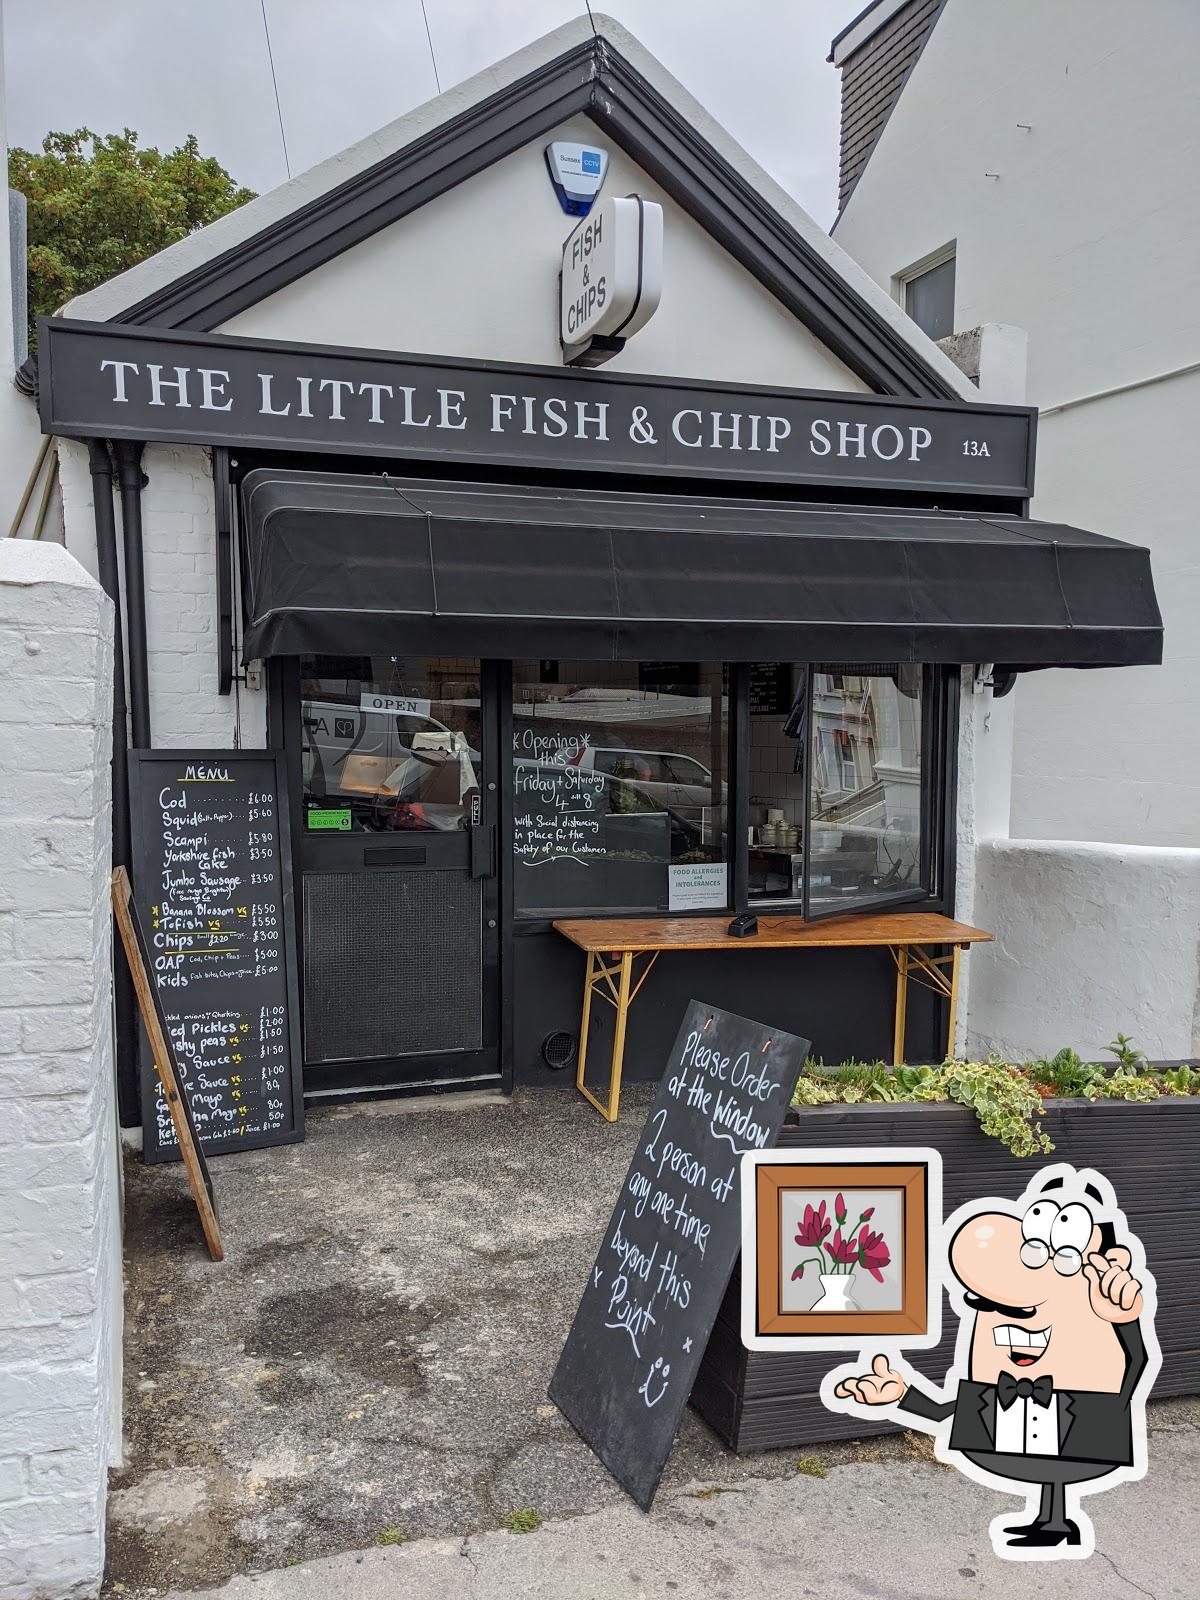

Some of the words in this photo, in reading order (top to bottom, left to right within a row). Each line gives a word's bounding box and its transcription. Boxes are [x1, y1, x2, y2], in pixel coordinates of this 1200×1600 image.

[583, 159, 600, 168] CCTV
[571, 214, 603, 270] FISH
[582, 264, 590, 286] &
[567, 276, 606, 334] CHIPS
[100, 359, 234, 411] THE
[257, 372, 469, 430] LITTLE
[489, 393, 610, 441] FISH
[629, 405, 658, 445] &
[671, 409, 792, 453] CHIP
[809, 418, 932, 462] SHOP
[962, 440, 991, 458] 13A
[372, 699, 418, 713] OPEN
[523, 729, 579, 759] Opening
[538, 751, 566, 766] this
[185, 765, 229, 780] MENU
[564, 766, 605, 793] Saturday
[159, 787, 187, 810] Cod
[555, 794, 570, 811] 4
[583, 792, 593, 809] 8
[162, 811, 198, 831] Squid
[562, 815, 599, 834] distancing
[163, 831, 208, 851] Scampi
[514, 829, 523, 840] in
[527, 829, 554, 843] place
[555, 828, 567, 842] for
[568, 829, 585, 839] the
[541, 841, 553, 854] of
[555, 845, 569, 853] our
[163, 849, 210, 868] Yorkshire
[161, 869, 196, 890] Jumbo
[200, 872, 242, 890] Sausage
[675, 880, 721, 888] INTOLERANCES
[162, 901, 193, 917] Banana
[195, 903, 234, 916] Blossom
[160, 916, 204, 931] Tofish
[153, 932, 194, 952] Chips
[157, 971, 189, 988] Kids
[192, 1020, 237, 1035] Pickles
[200, 1036, 227, 1054] peas
[193, 1055, 231, 1070] Sauce
[680, 1031, 730, 1081] Please
[731, 1051, 781, 1102] Order
[197, 1073, 229, 1090] Sauce
[191, 1093, 223, 1110] Mayo
[668, 1068, 687, 1099] at
[687, 1075, 712, 1115] the
[712, 1090, 770, 1149] Window
[211, 1108, 237, 1121] Mayo
[645, 1109, 668, 1162] 2
[657, 1142, 707, 1188] person
[710, 1167, 735, 1203] at
[629, 1172, 652, 1218] any
[651, 1190, 675, 1224] one
[674, 1194, 711, 1256] time
[610, 1210, 659, 1282] beyond
[657, 1250, 692, 1309] this
[608, 1274, 656, 1336] Point
